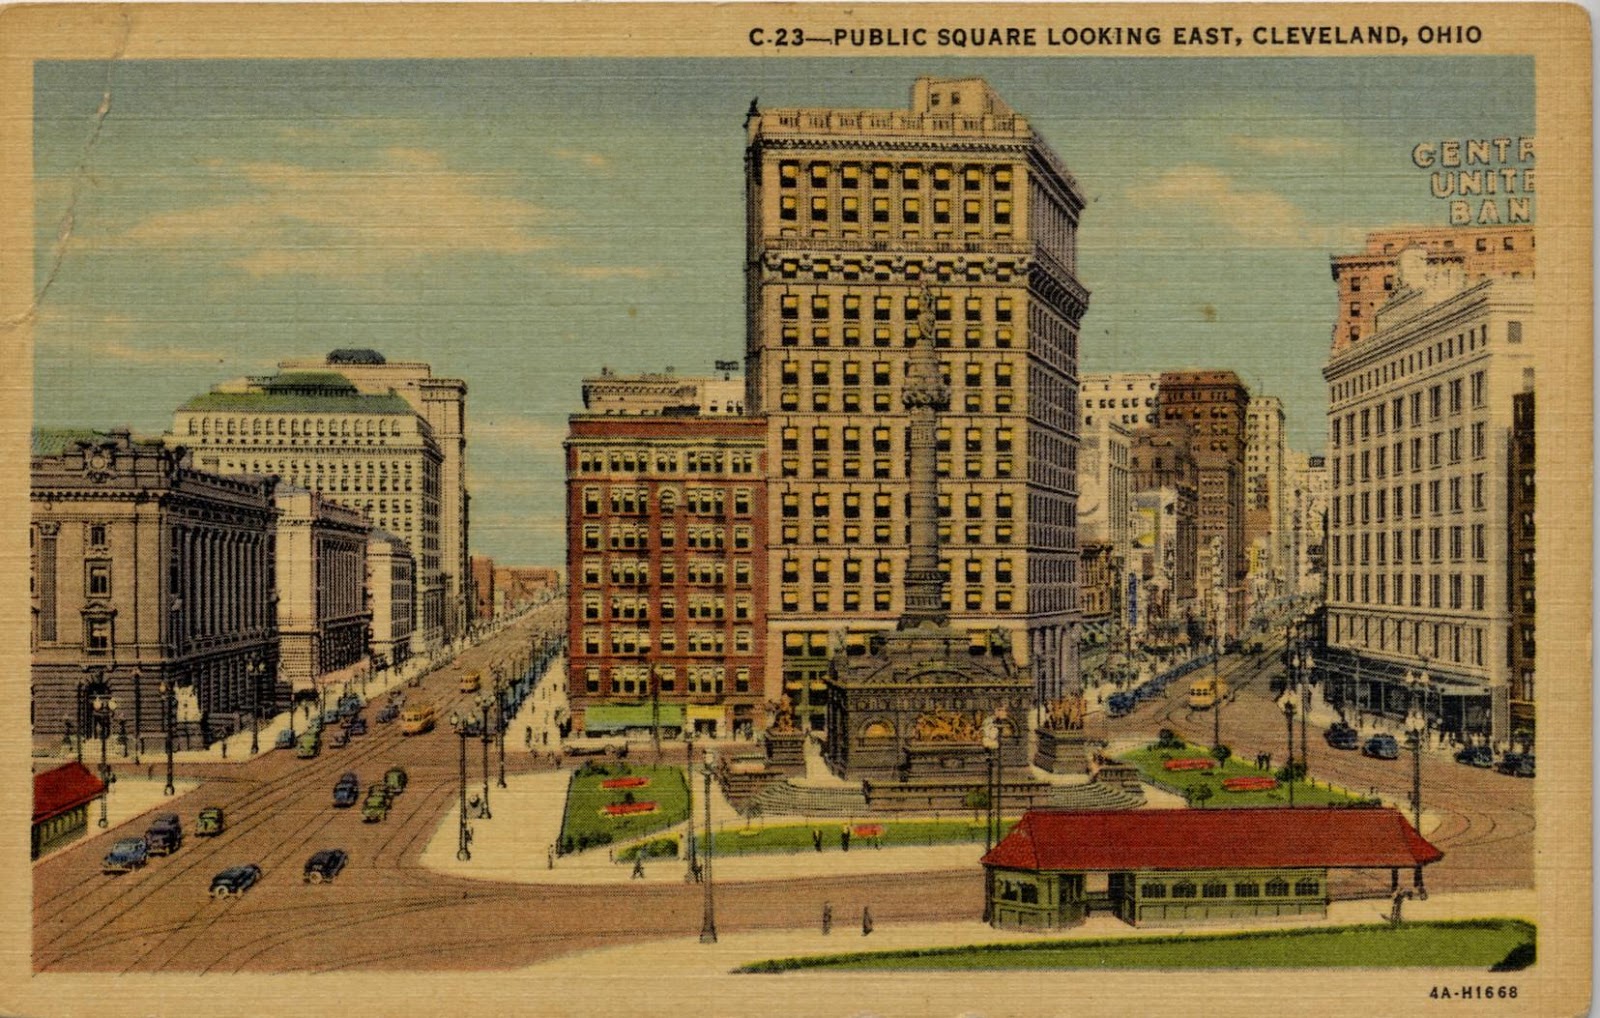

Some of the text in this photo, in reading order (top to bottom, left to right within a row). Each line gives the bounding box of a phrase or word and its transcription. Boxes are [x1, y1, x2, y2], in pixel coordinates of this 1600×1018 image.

[937, 27, 1037, 48] SQUARE
[1047, 27, 1161, 46] LOOKING
[1173, 26, 1243, 47] EAST,
[1252, 26, 1409, 46] CLEVELAND,
[1417, 25, 1482, 44] OHIO
[1411, 136, 1534, 169] CENTR
[1449, 197, 1531, 226] BAN
[1429, 985, 1518, 1000] 4A-H1668
